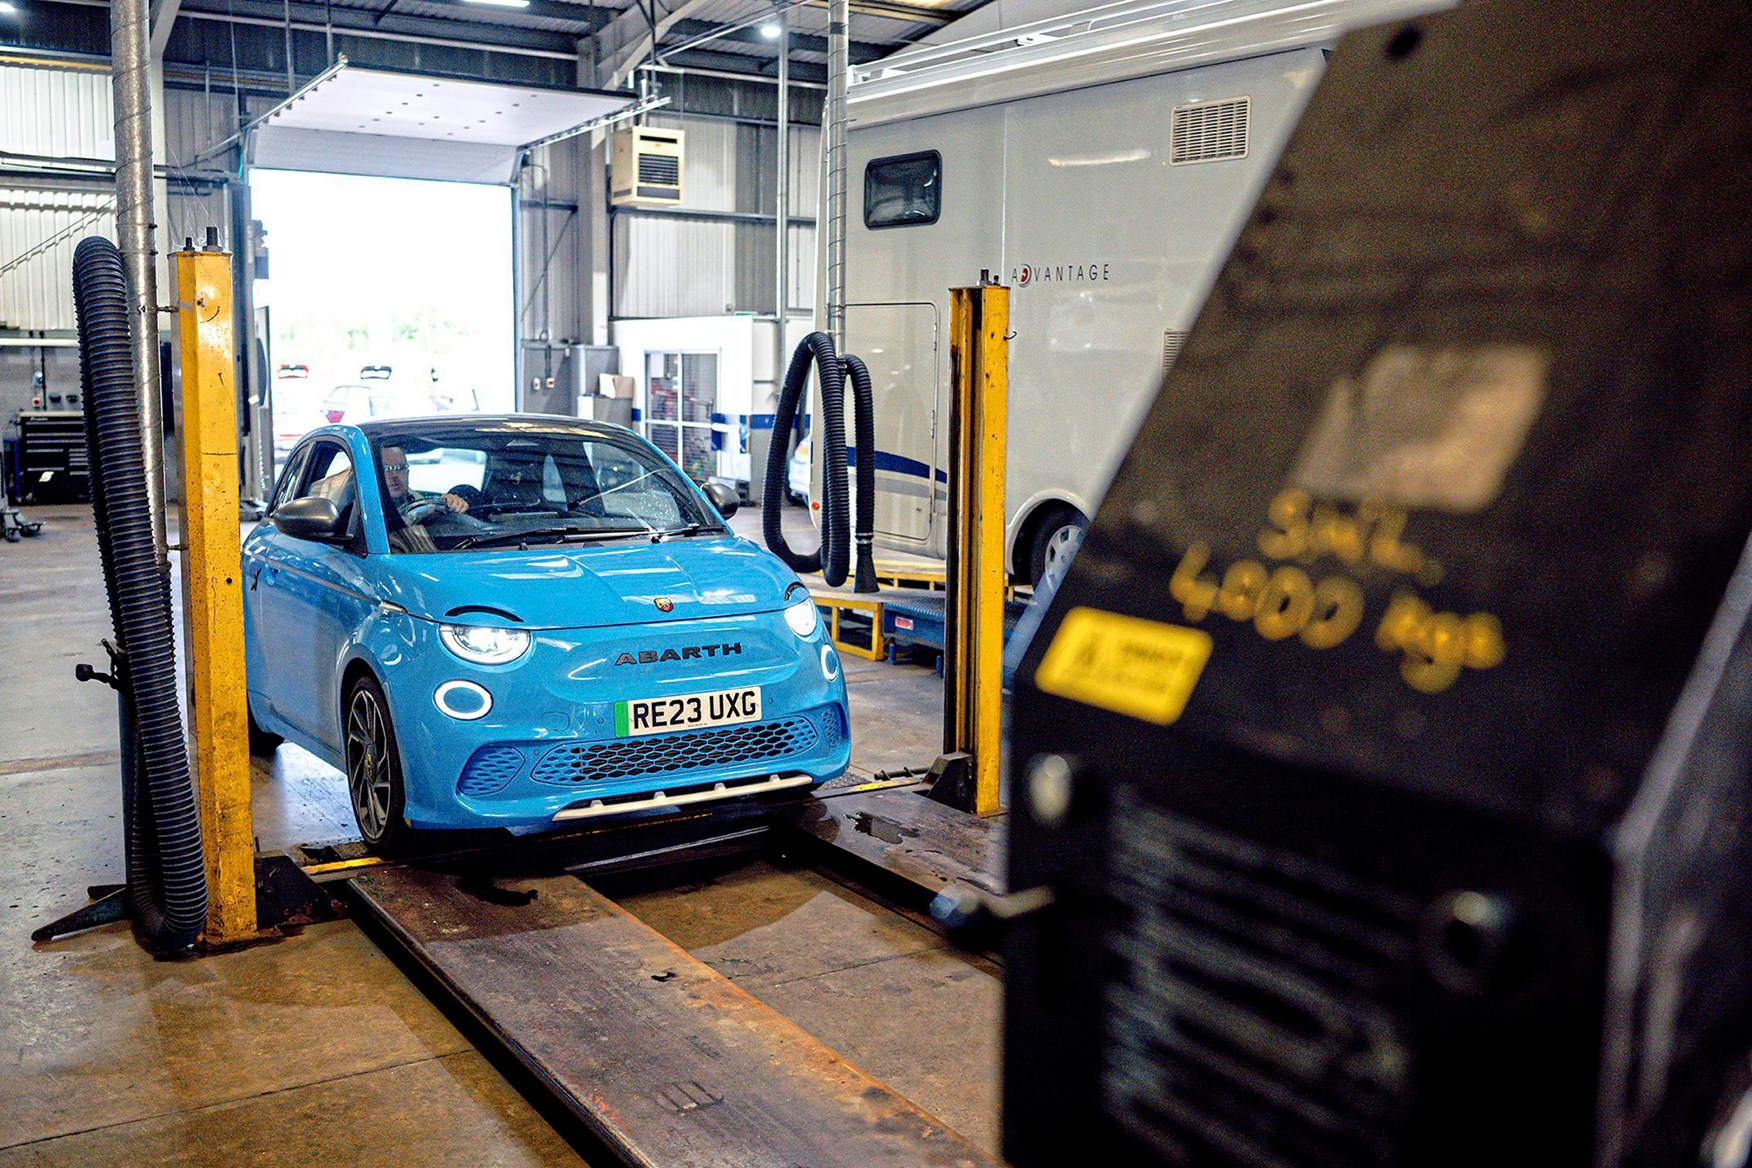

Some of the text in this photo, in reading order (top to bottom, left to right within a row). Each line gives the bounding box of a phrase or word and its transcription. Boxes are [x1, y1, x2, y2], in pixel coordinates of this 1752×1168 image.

[1011, 264, 1109, 288] ADVANTAGE
[614, 642, 742, 667] ABARTH
[633, 691, 757, 730] RE23 UXG
